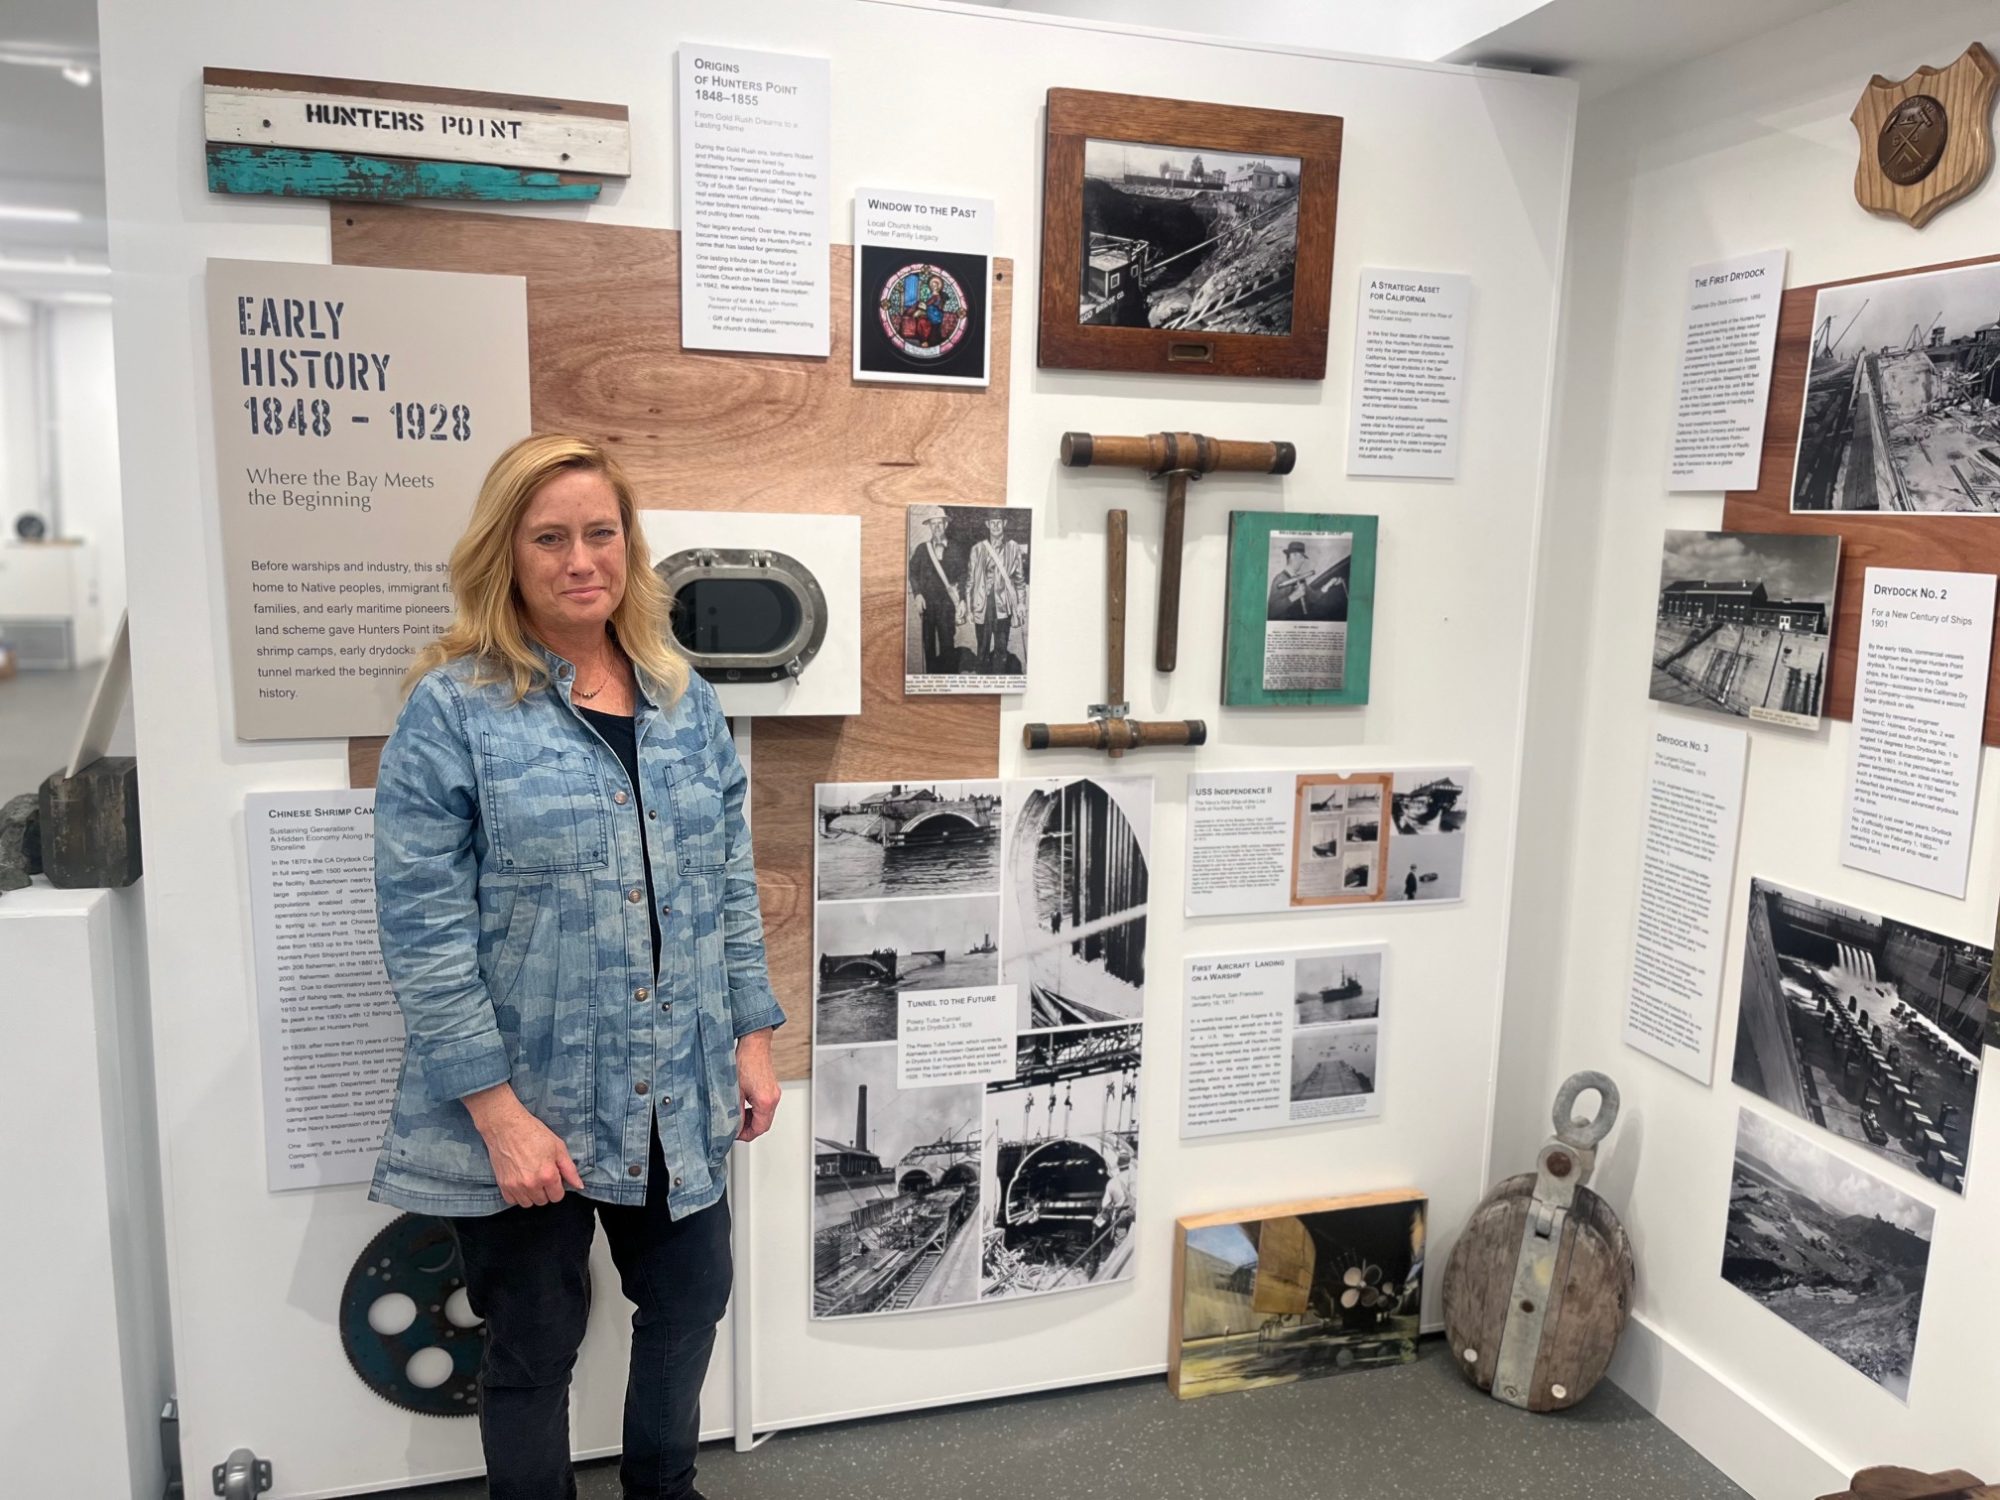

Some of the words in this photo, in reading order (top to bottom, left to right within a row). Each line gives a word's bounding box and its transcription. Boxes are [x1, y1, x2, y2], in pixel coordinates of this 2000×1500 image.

[694, 58, 740, 73] ORIGINS
[694, 75, 709, 85] OF
[711, 75, 762, 91] HUNTERS
[766, 81, 797, 95] POINT
[305, 104, 424, 131] HUNTERS
[442, 116, 522, 139] POINT
[867, 199, 912, 212] WINDOW
[914, 204, 927, 214] TO
[929, 206, 948, 216] THE
[950, 206, 976, 218] PAST
[867, 219, 886, 227] Local
[887, 221, 911, 229] Church
[912, 224, 932, 232] Holds
[867, 229, 890, 237] Hunter
[891, 230, 914, 240] Family
[915, 233, 939, 242] Legacy
[1694, 279, 1708, 288] THE
[1708, 275, 1729, 285] FIRST
[1729, 268, 1765, 282] DRYDOCK
[1370, 281, 1377, 289] A
[1379, 281, 1416, 292] STRATEGIC
[1417, 285, 1440, 293] ASSET
[1370, 292, 1384, 300] FOR
[1385, 293, 1426, 303] CALIFORNIA
[238, 296, 344, 340] EARLY
[241, 347, 390, 391] HISTORY
[244, 396, 331, 437] 1848
[389, 402, 471, 442] 1928
[246, 467, 308, 485] Where
[313, 469, 341, 486] the
[346, 471, 378, 492] Bay
[384, 472, 434, 488] Meets
[248, 488, 276, 505] the
[282, 490, 372, 512] Beginning
[251, 560, 289, 571] Before
[291, 561, 340, 573] warships
[343, 561, 364, 572] and
[367, 561, 411, 574] industry,
[414, 562, 432, 572] this
[252, 582, 284, 592] home
[287, 583, 298, 592] to
[301, 582, 336, 592] Native
[339, 583, 384, 595] peoples,
[388, 584, 440, 595] immigrant
[1874, 584, 1918, 597] DRYDOCK
[1920, 588, 1938, 599] NO.
[1940, 589, 1947, 600] 2
[253, 603, 300, 614] families,
[303, 604, 324, 613] and
[326, 604, 353, 616] early
[356, 604, 402, 613] maritime
[405, 605, 453, 615] pioneers.
[1871, 608, 1884, 617] For
[1892, 610, 1908, 619] New
[1910, 611, 1939, 624] Century
[1940, 615, 1950, 623] of
[1950, 615, 1973, 626] Ships
[1871, 619, 1888, 628] 1901
[255, 625, 279, 635] land
[282, 625, 326, 635] scheme
[328, 627, 355, 637] gave
[358, 624, 400, 634] Hunters
[403, 624, 430, 634] Point
[256, 646, 294, 658] shrimp
[297, 648, 337, 657] camps,
[339, 645, 366, 657] early
[257, 667, 292, 677] tunnel
[295, 666, 336, 676] marked
[339, 666, 356, 676] the
[358, 666, 408, 678] beginnin
[259, 688, 298, 700] history.
[268, 809, 312, 818] CHINESE
[314, 808, 352, 817] SHRIMP
[354, 806, 375, 816] CAM
[306, 834, 341, 842] Economy
[1216, 962, 1250, 970] AIRCRAFT
[1255, 960, 1285, 968] LANDING
[906, 1000, 937, 1008] TUNNEL
[967, 995, 996, 1003] FUTURE
